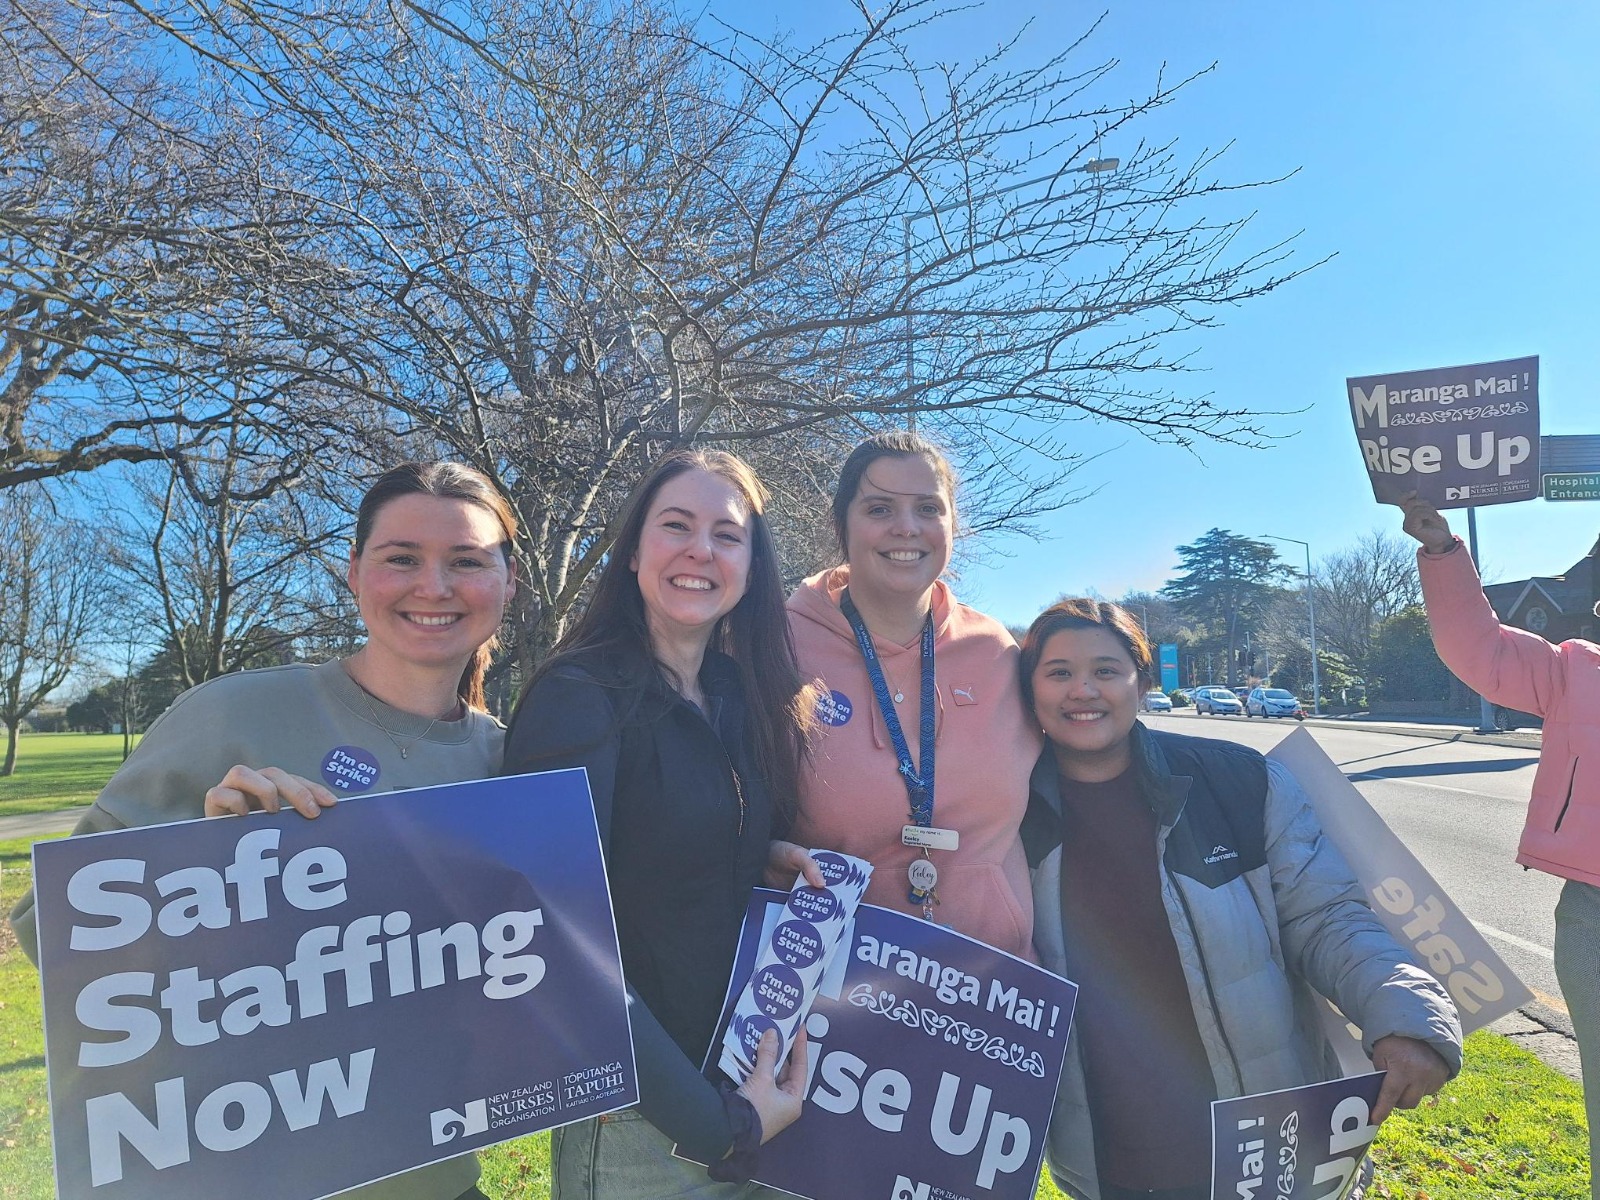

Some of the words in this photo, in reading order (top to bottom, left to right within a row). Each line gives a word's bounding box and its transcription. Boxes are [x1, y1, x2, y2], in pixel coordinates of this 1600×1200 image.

[1352, 383, 1468, 429] Maranga
[1361, 435, 1441, 475] Rise
[1457, 431, 1531, 476] Up
[1550, 477, 1599, 487] Hospital
[1550, 489, 1600, 499] Entranc
[818, 702, 846, 721] Strike
[837, 704, 850, 714] on
[326, 761, 371, 785] Strike
[332, 750, 356, 766] I'm
[358, 763, 377, 775] on
[830, 863, 845, 871] on
[1203, 850, 1239, 864] Kathmandu
[820, 869, 842, 879] rike
[66, 828, 348, 952] Safe
[796, 890, 815, 900] I'm
[817, 896, 832, 906] on
[793, 899, 829, 914] Strike
[777, 937, 814, 959] Strike
[781, 926, 800, 940] I'm
[802, 936, 818, 948] on
[856, 934, 981, 1005] aranga
[76, 908, 547, 1068] Staffing
[758, 984, 795, 1009] Strike
[762, 972, 782, 989] I'm
[783, 984, 799, 998] on
[746, 1022, 762, 1039] I'm
[488, 1092, 510, 1104] NEW
[511, 1081, 553, 1099] ZEALAND
[563, 1072, 625, 1100] TAPUHI
[595, 1087, 626, 1101] AOTEAROA
[490, 1090, 555, 1119] NURSES
[802, 1013, 912, 1132] ise
[930, 1071, 1031, 1190] Up
[86, 1047, 376, 1188] Now
[491, 1104, 556, 1129] ORGANISATION
[931, 1186, 946, 1196] NEW
